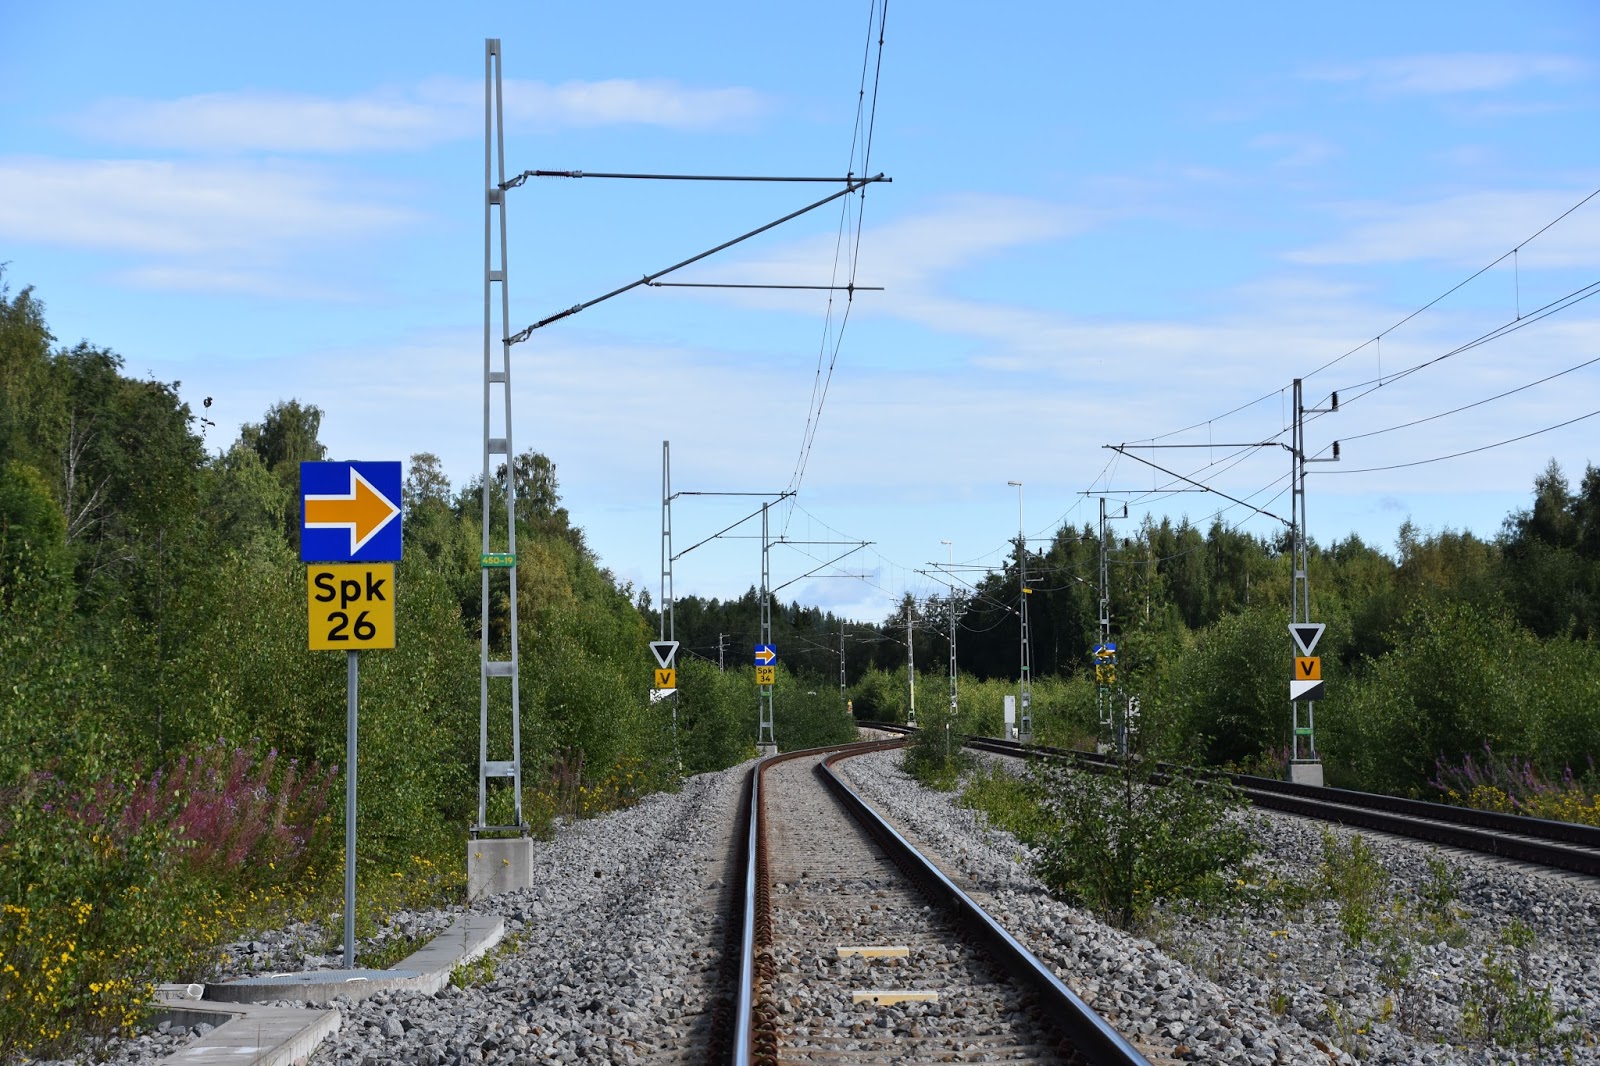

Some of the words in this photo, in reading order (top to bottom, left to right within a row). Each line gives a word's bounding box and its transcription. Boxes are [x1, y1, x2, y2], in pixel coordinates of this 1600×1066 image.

[482, 556, 513, 564] 450-19
[314, 571, 387, 610] Spk
[327, 610, 377, 641] 26
[757, 667, 772, 675] Spk
[1301, 661, 1314, 676] V
[660, 672, 671, 684] V
